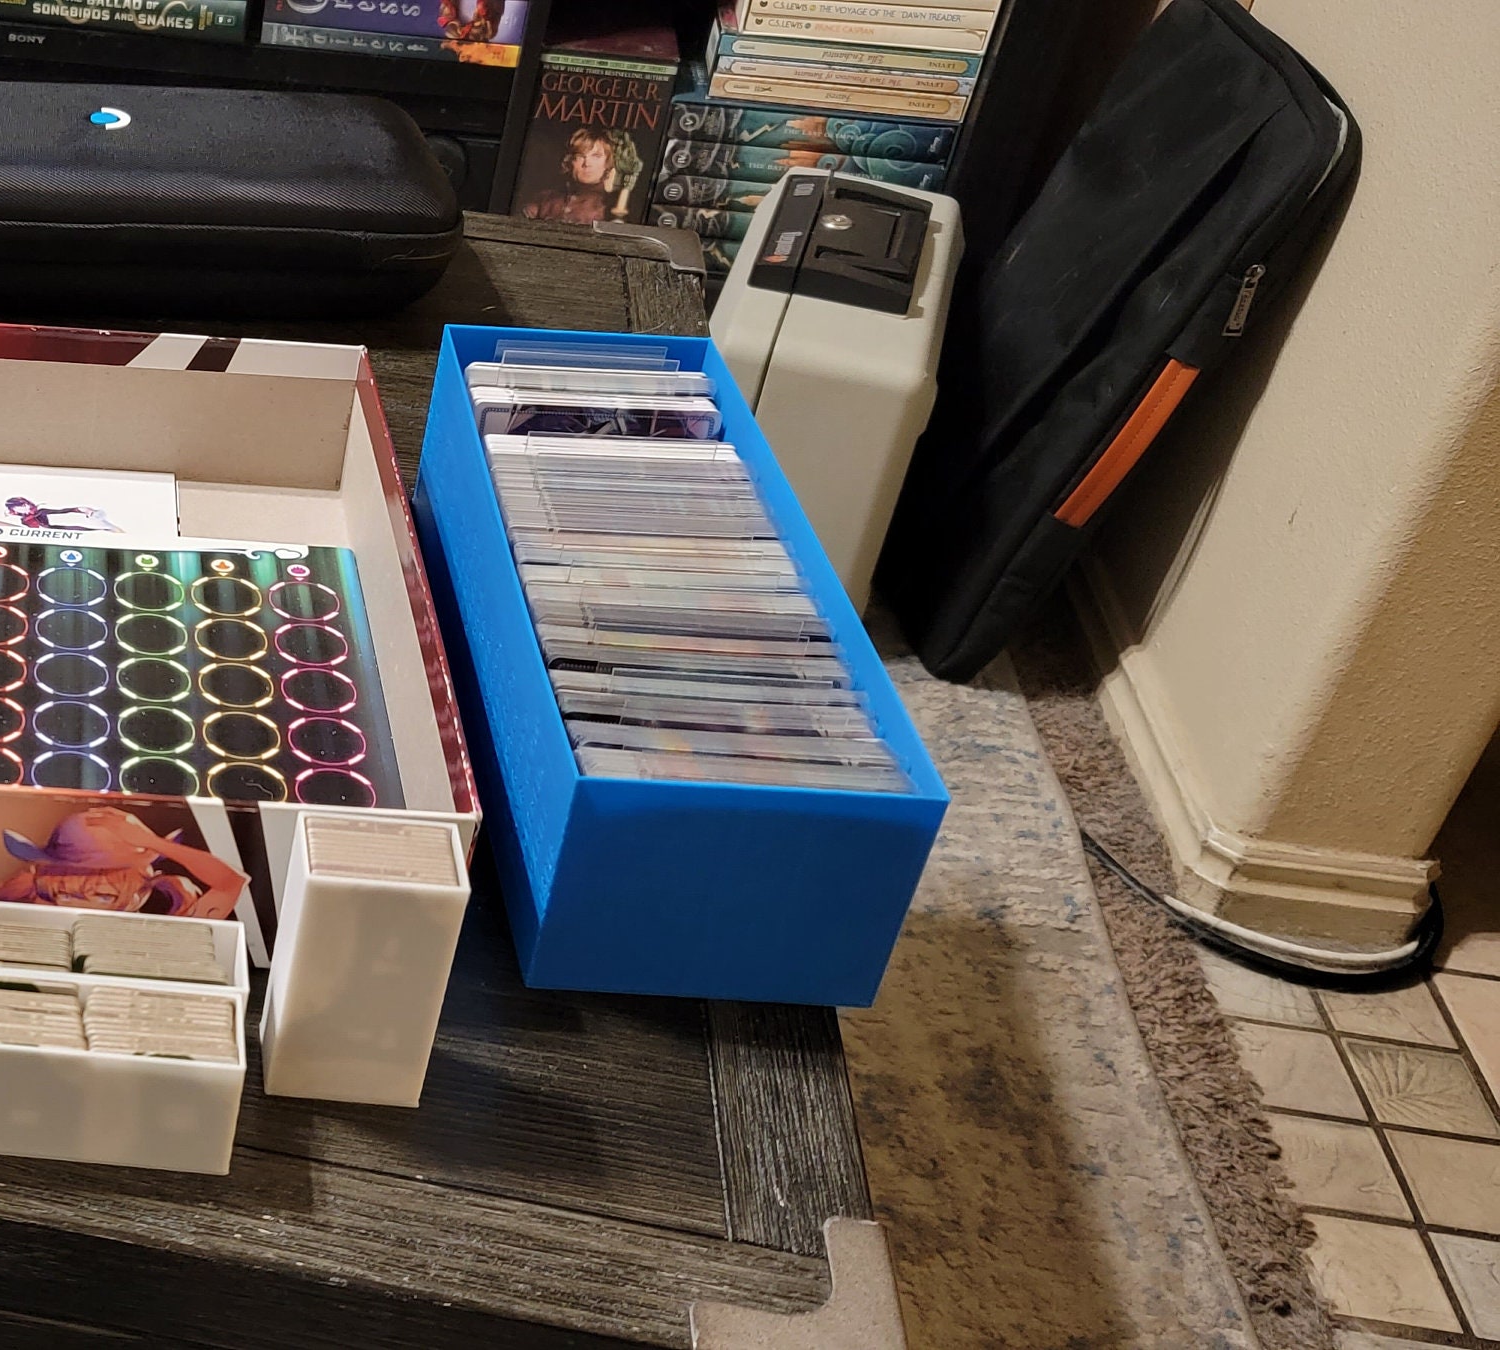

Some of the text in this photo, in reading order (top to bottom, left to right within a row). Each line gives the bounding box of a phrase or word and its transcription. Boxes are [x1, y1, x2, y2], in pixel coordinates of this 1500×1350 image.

[32, 3, 194, 30] SONGBIRDS AND SNAKES
[820, 5, 833, 13] THE
[835, 6, 868, 16] VOYAGE
[869, 8, 881, 16] OF
[883, 10, 896, 18] THE
[8, 33, 46, 44] SONY
[542, 72, 622, 98] GEORGE
[534, 93, 661, 131] MARTIN
[9, 528, 83, 541] CURRENT
